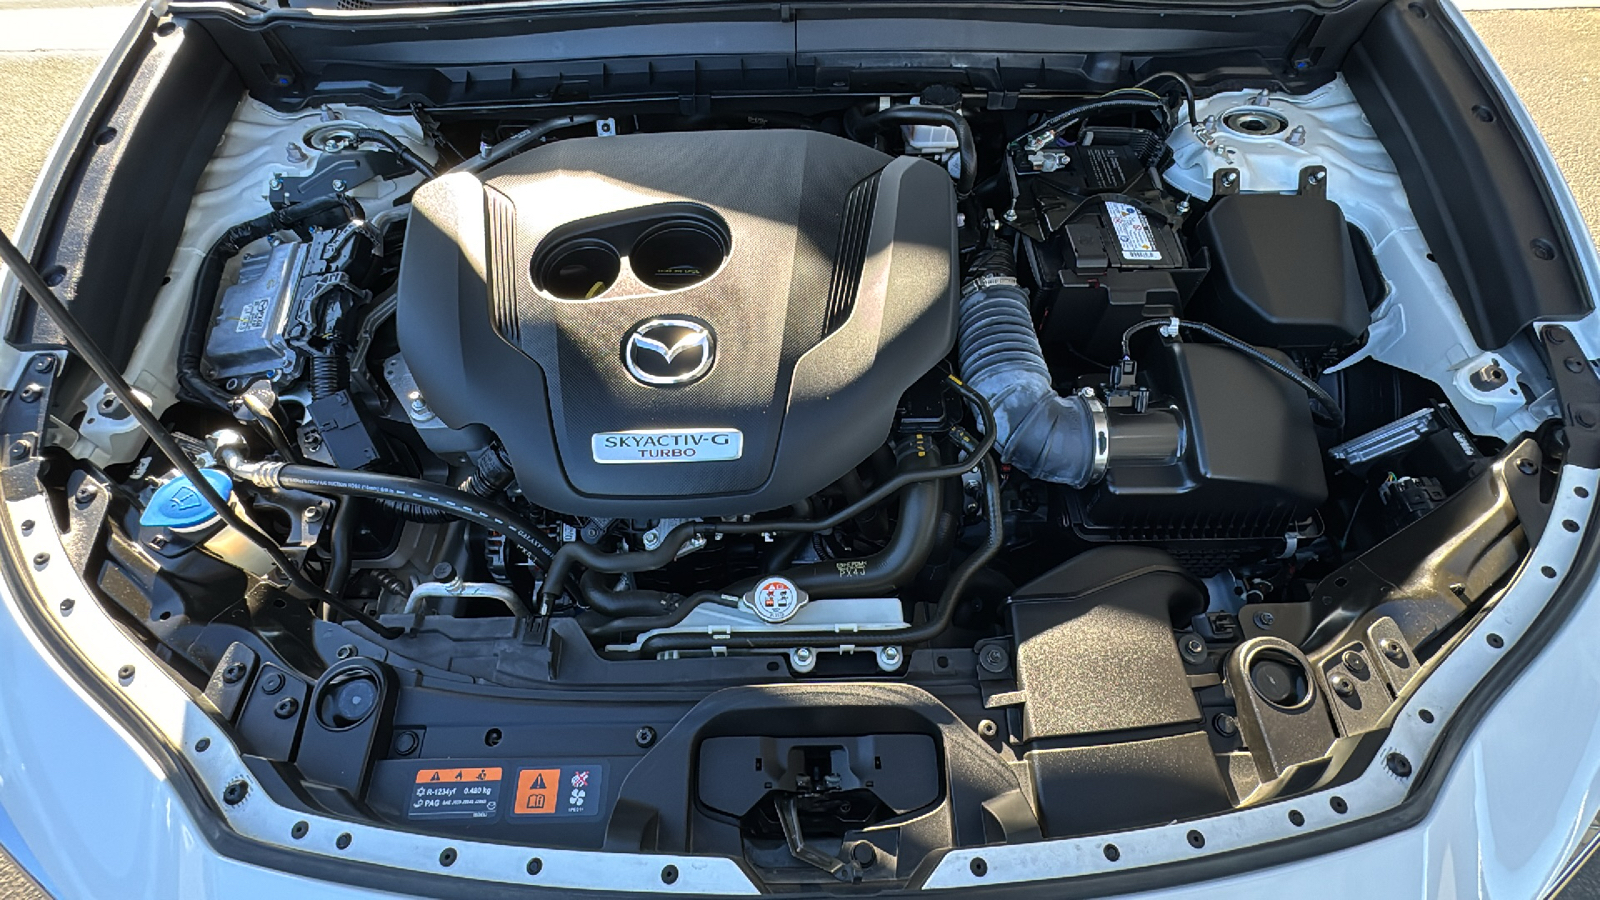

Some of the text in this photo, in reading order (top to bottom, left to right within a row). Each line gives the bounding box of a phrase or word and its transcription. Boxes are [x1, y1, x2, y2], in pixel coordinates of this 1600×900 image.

[605, 434, 729, 448] SKYACTIV-G
[637, 448, 696, 458] TURBO
[517, 530, 544, 548] GALAXY
[426, 787, 457, 797] R-1234yf
[483, 786, 492, 795] kg
[424, 799, 440, 807] PAG
